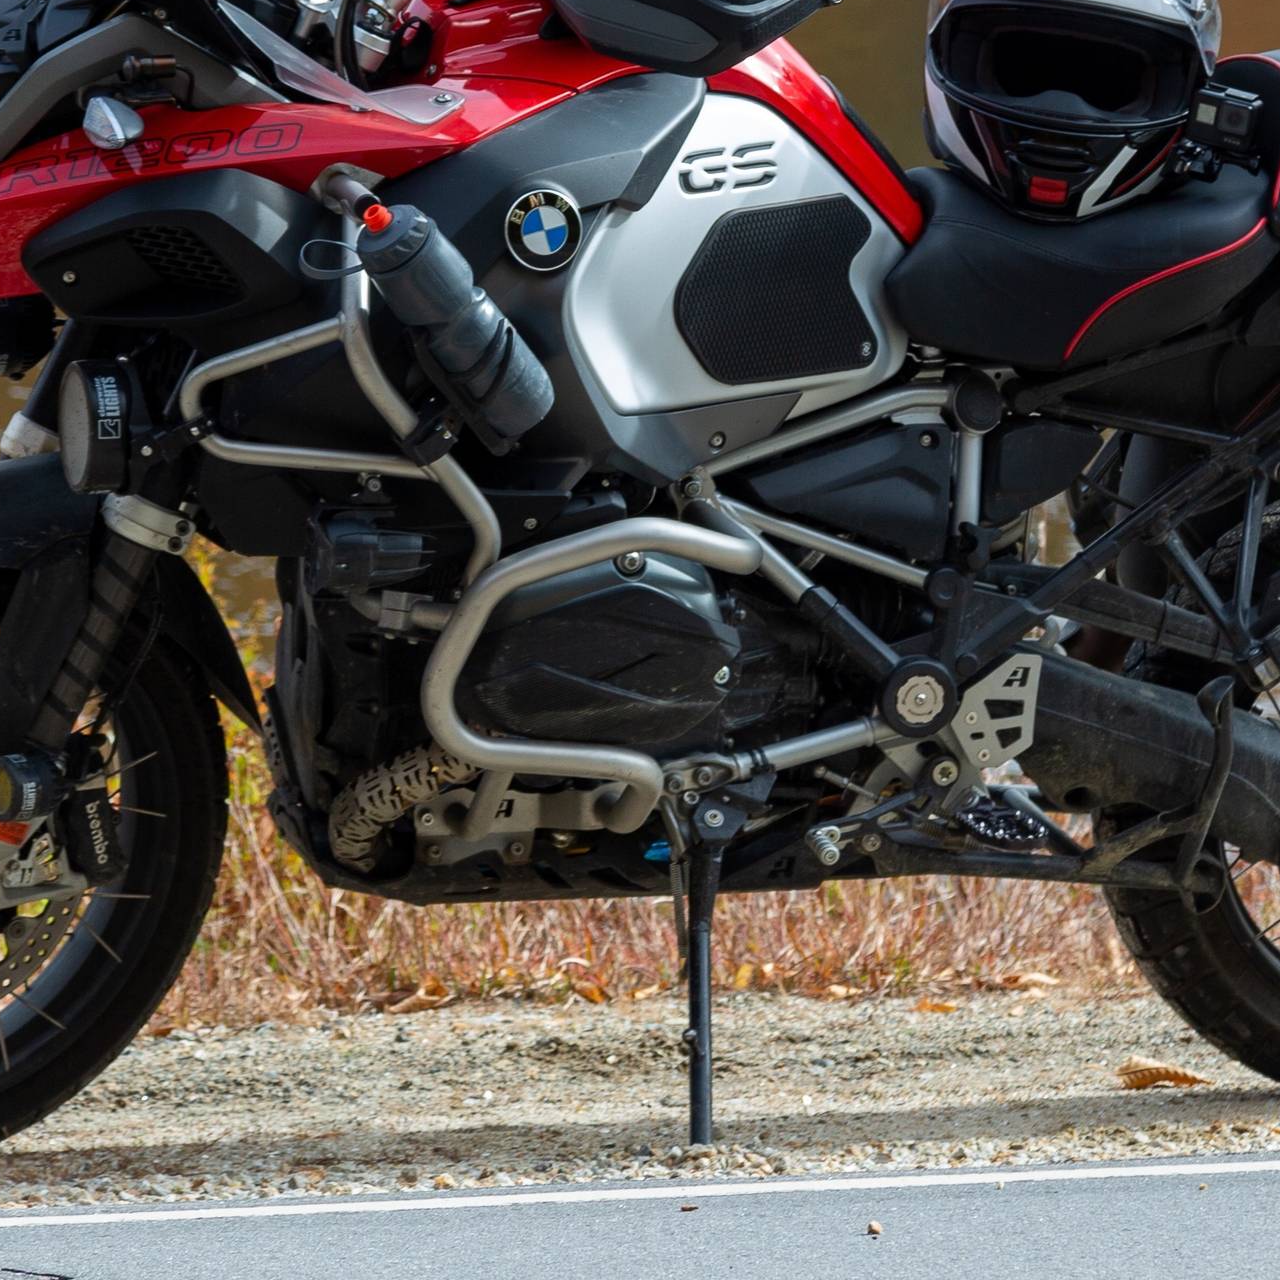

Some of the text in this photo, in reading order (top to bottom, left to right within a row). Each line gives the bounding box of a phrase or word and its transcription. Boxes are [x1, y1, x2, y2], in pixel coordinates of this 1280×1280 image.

[678, 141, 778, 195] GS
[510, 192, 571, 226] BMW
[101, 376, 121, 417] LIGHTS
[85, 800, 110, 865] brembo
